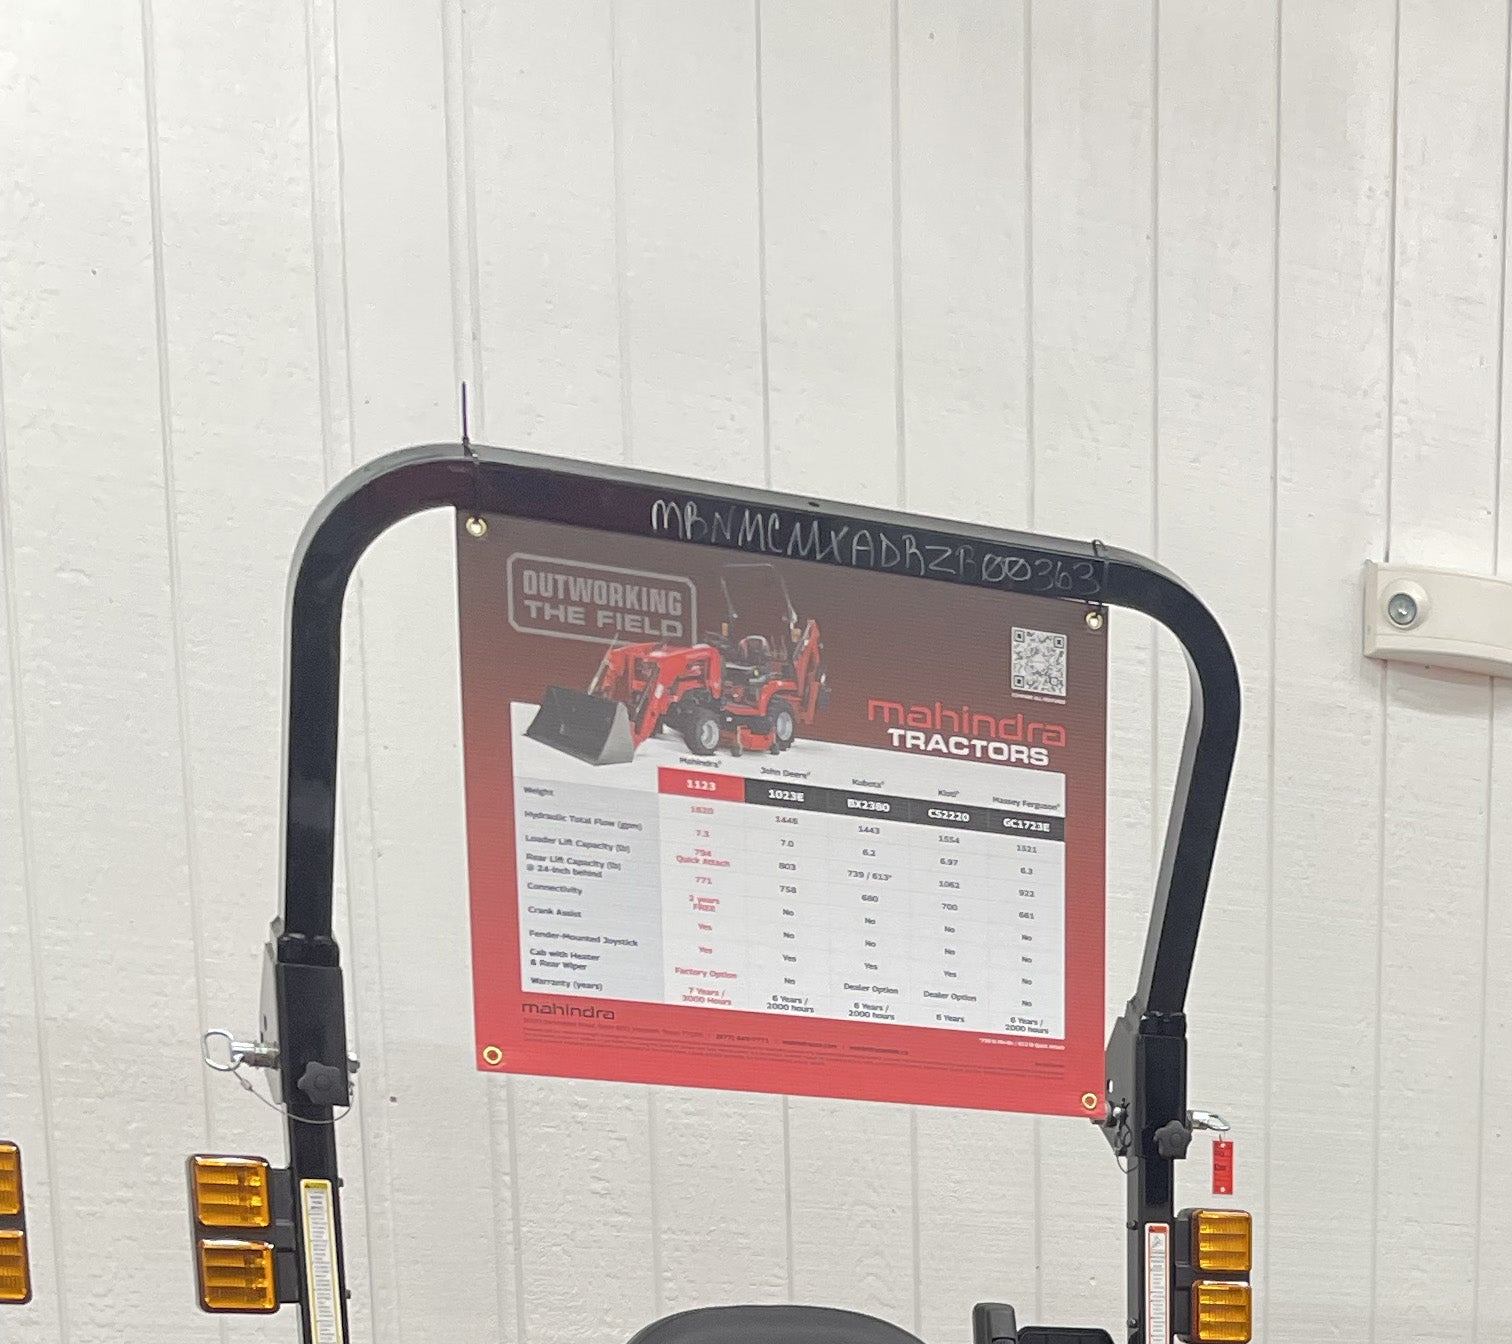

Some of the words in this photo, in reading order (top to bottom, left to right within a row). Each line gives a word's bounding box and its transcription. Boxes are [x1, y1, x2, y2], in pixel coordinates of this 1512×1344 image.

[522, 569, 684, 617] OUTWORKING
[523, 600, 587, 626] THE
[596, 610, 684, 638] FIELD
[867, 699, 1067, 748] mahindra
[887, 727, 1050, 767] TRACTORS
[687, 779, 716, 792] 1123
[768, 789, 805, 802] 1023E
[522, 1001, 615, 1021] mahindra
